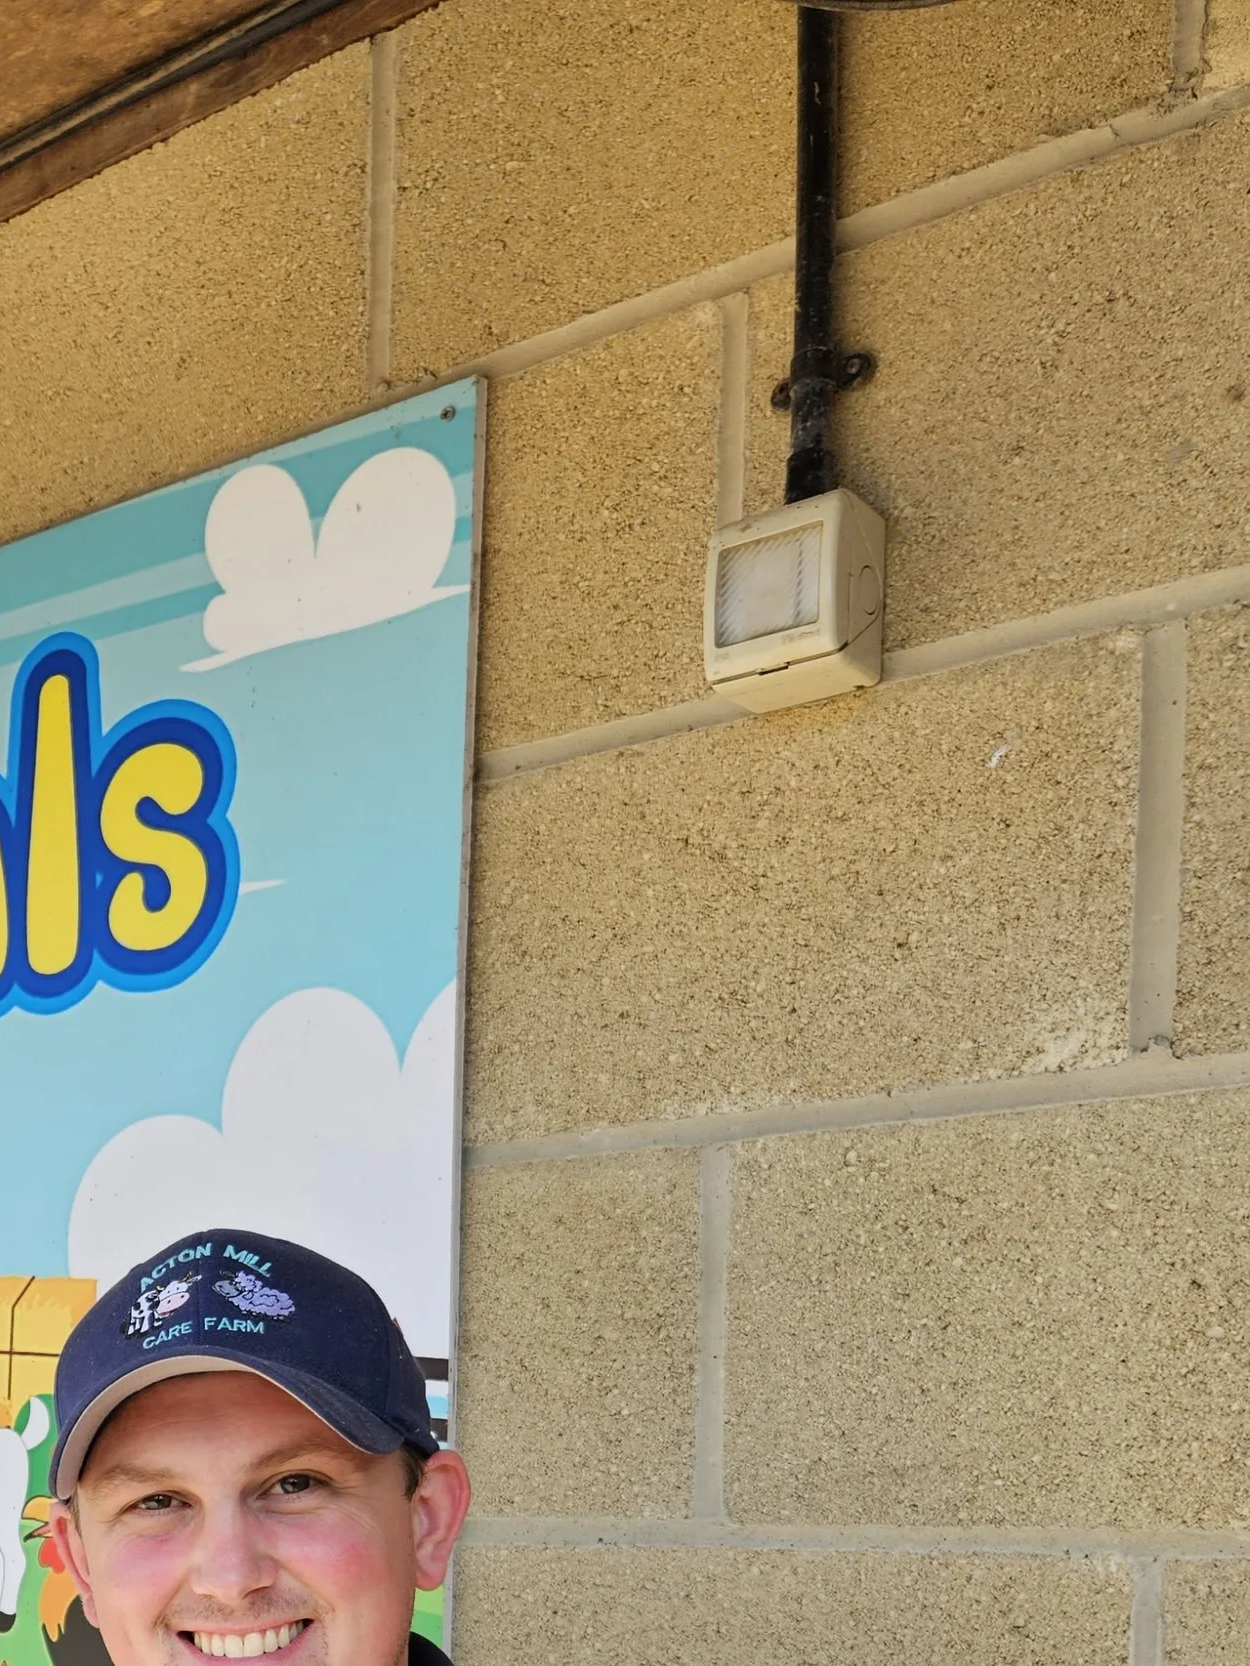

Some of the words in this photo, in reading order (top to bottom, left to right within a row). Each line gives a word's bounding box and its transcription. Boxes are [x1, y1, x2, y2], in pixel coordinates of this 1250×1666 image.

[139, 1243, 212, 1292] ACTON
[223, 1245, 272, 1277] MILL
[142, 1321, 193, 1350] CARE
[204, 1317, 265, 1335] FARM
